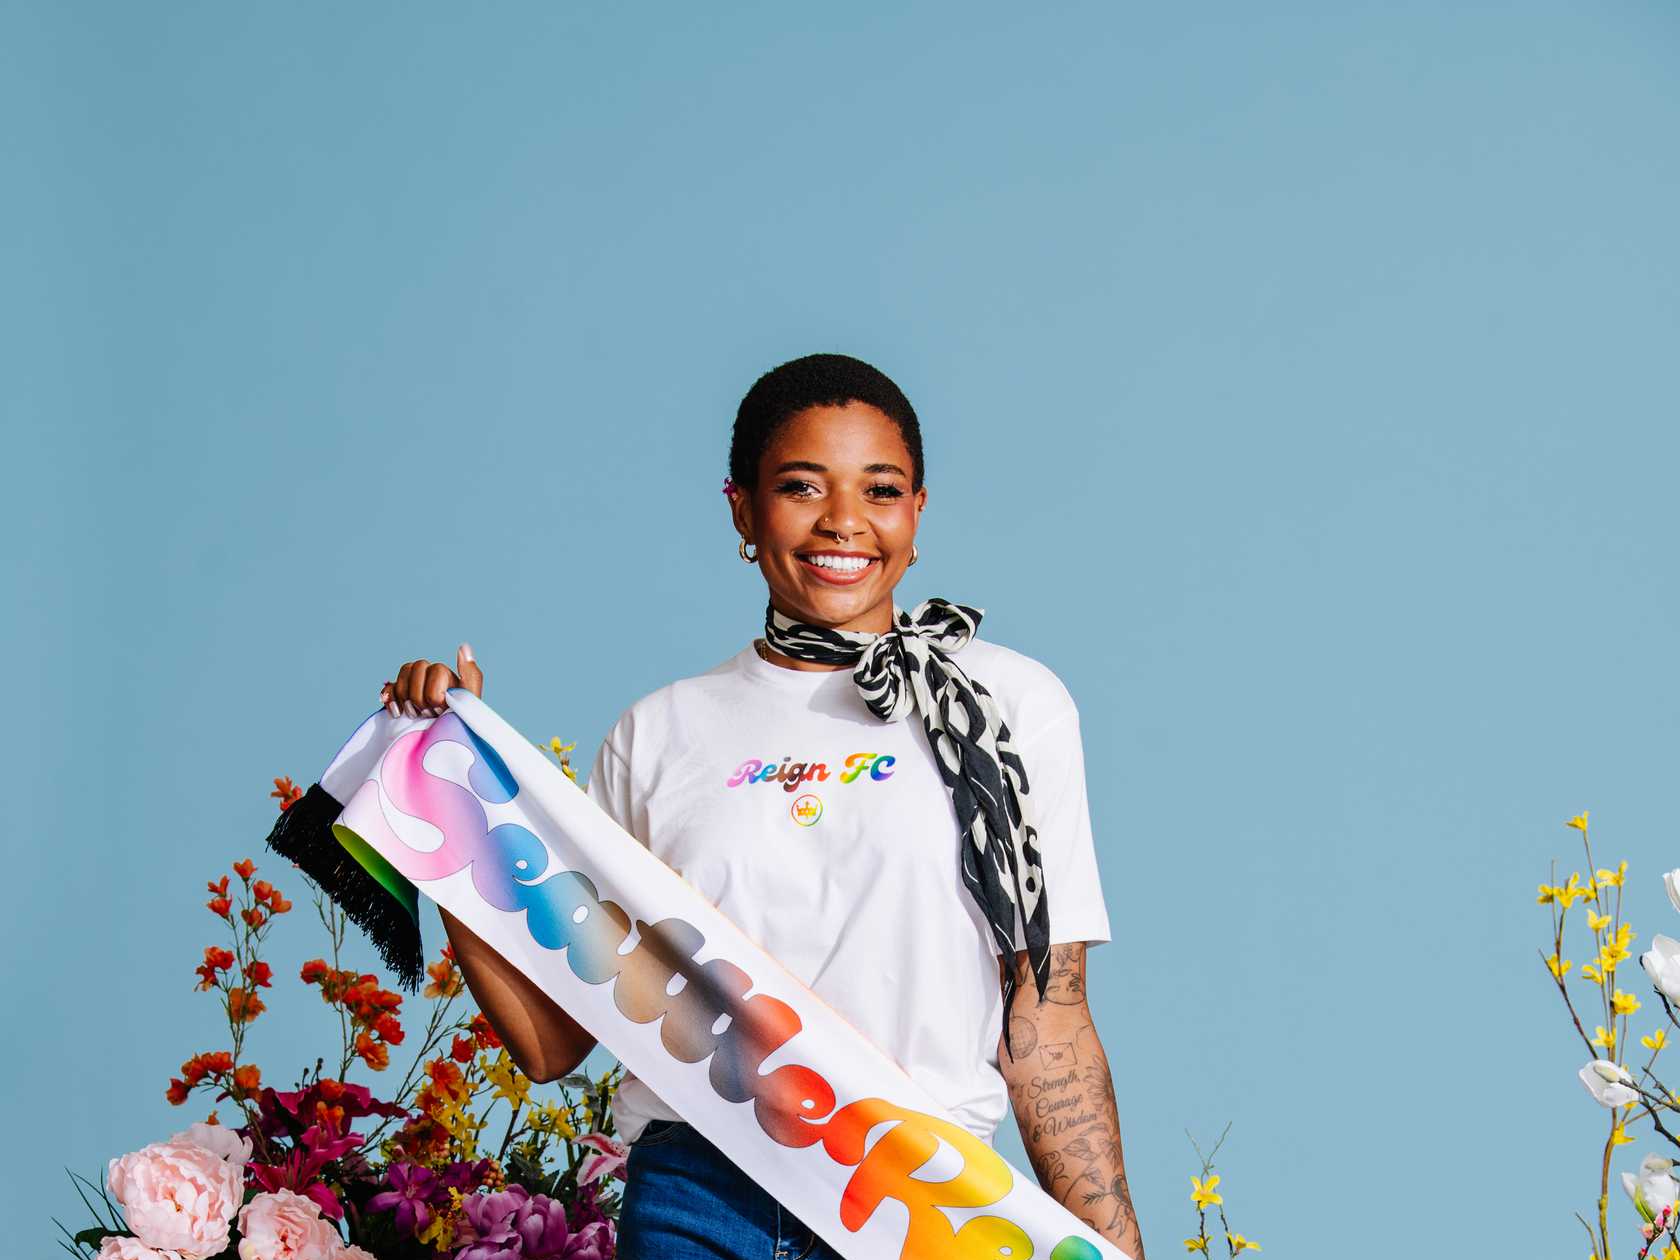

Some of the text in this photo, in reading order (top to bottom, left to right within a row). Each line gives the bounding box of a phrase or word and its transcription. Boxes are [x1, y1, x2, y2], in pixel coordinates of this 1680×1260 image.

[726, 752, 896, 793] Reign FC
[341, 711, 838, 1149] Seattle
[1035, 1092, 1083, 1119] Courage
[1032, 1111, 1097, 1143] & Wisdom
